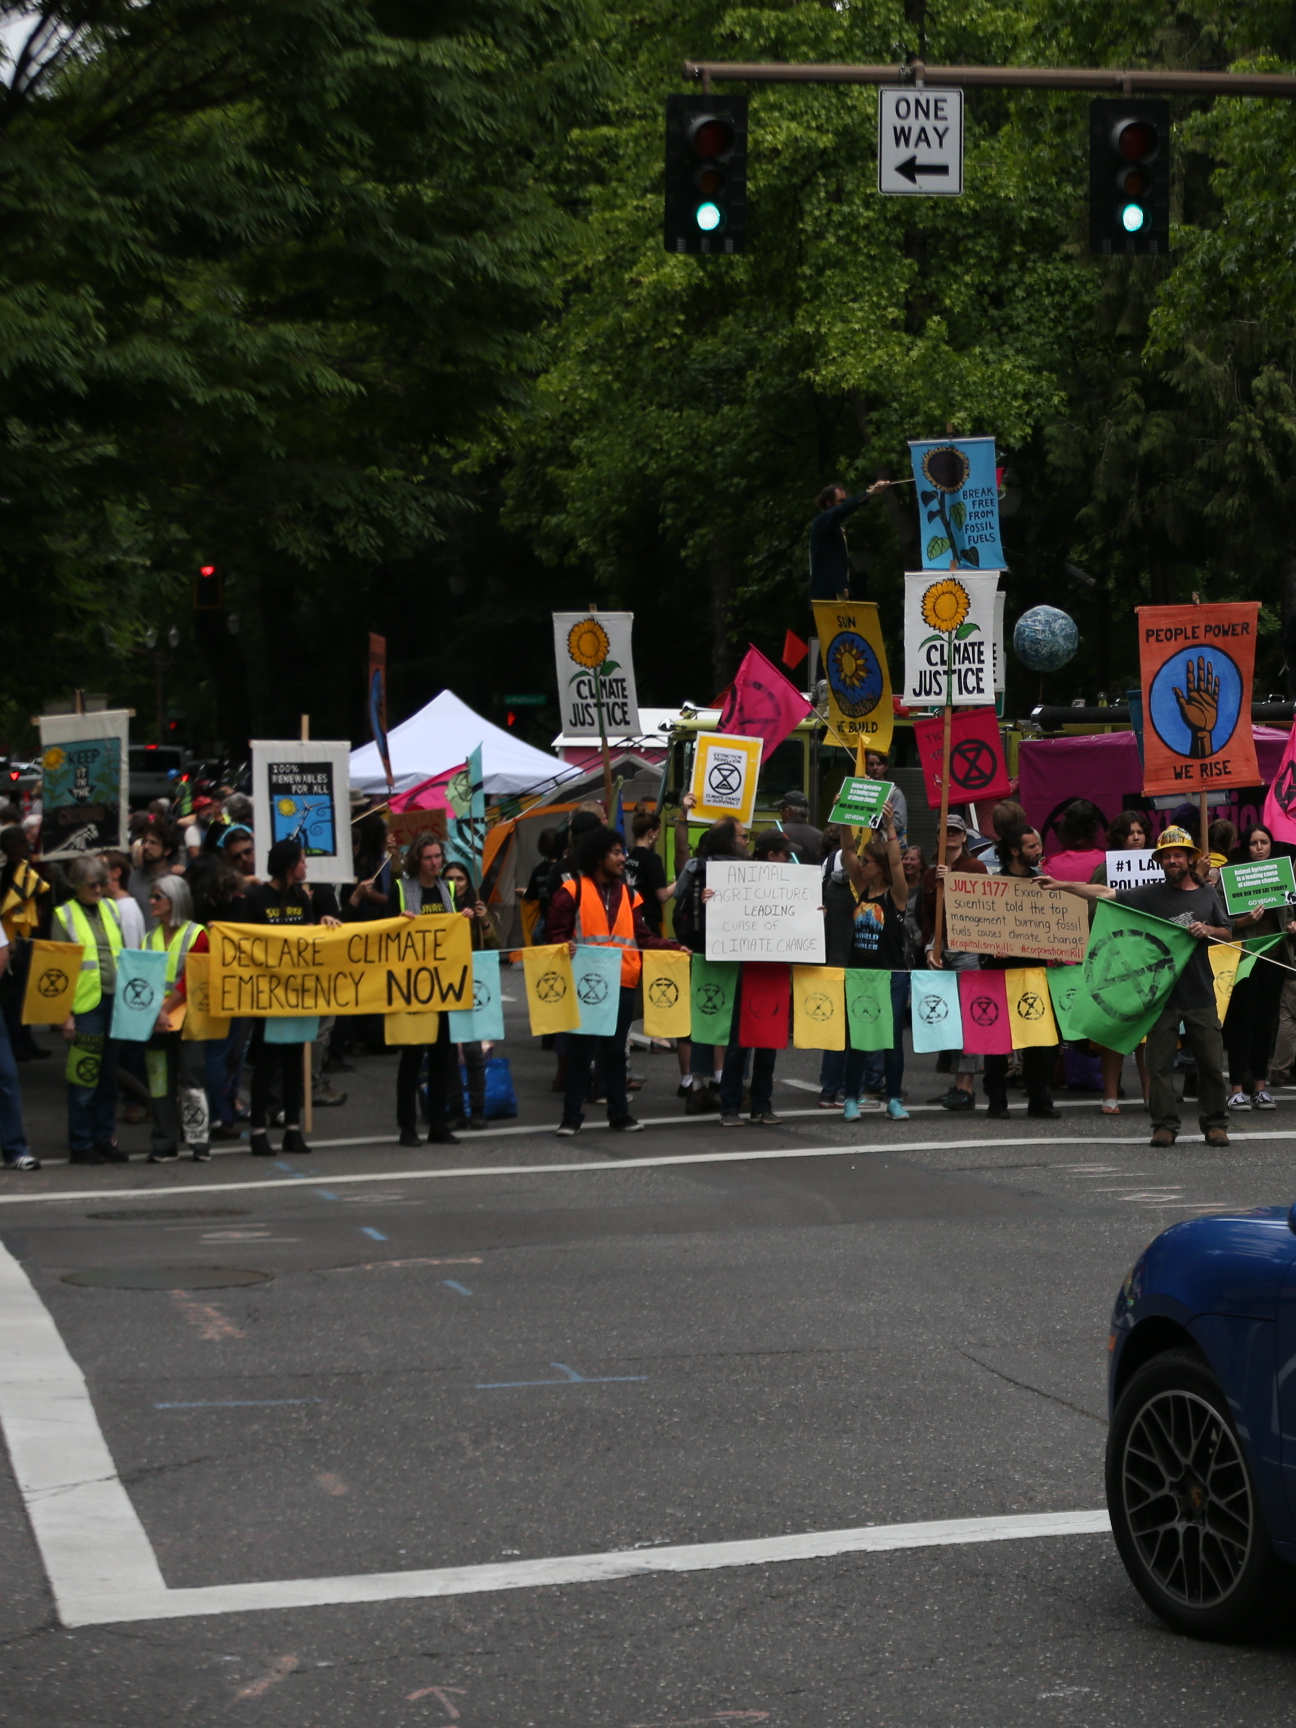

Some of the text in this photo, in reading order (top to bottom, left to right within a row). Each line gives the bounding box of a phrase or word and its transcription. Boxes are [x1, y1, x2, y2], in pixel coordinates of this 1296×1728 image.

[895, 98, 948, 121] ONE
[893, 126, 949, 149] WAY
[963, 488, 994, 500] BREAK
[973, 498, 995, 509] FREE
[969, 510, 994, 520] FROM
[965, 523, 994, 534] FOSSIL
[968, 533, 995, 545] FUELS
[837, 615, 857, 629] SUN
[1146, 622, 1250, 643] PEOPLE POWER
[913, 668, 984, 697] JUSTICE
[569, 702, 631, 728] JUSTICE
[849, 721, 878, 733] BUILD
[68, 748, 99, 767] KEEP
[1173, 760, 1232, 780] WE RISE
[272, 773, 328, 785] RENEWABLES
[291, 783, 329, 794] FOR ALL
[1116, 860, 1131, 872] #1
[728, 866, 789, 884] ANIMAL
[950, 879, 978, 894] JULY
[1015, 884, 1042, 898] Exxon
[1049, 890, 1061, 900] oil
[744, 905, 795, 917] LEADING
[955, 899, 1068, 920] scientist told the top
[723, 921, 757, 932] CUASE
[951, 913, 1081, 933] management burning fossil
[950, 939, 1013, 952] #capitalismkills
[951, 925, 1085, 949] fuels causes climate change
[221, 929, 447, 968] DECLARE CLIMATE
[711, 938, 817, 955] CLIMATE CHANGE
[221, 965, 468, 1011] EMERGENCY NOW
